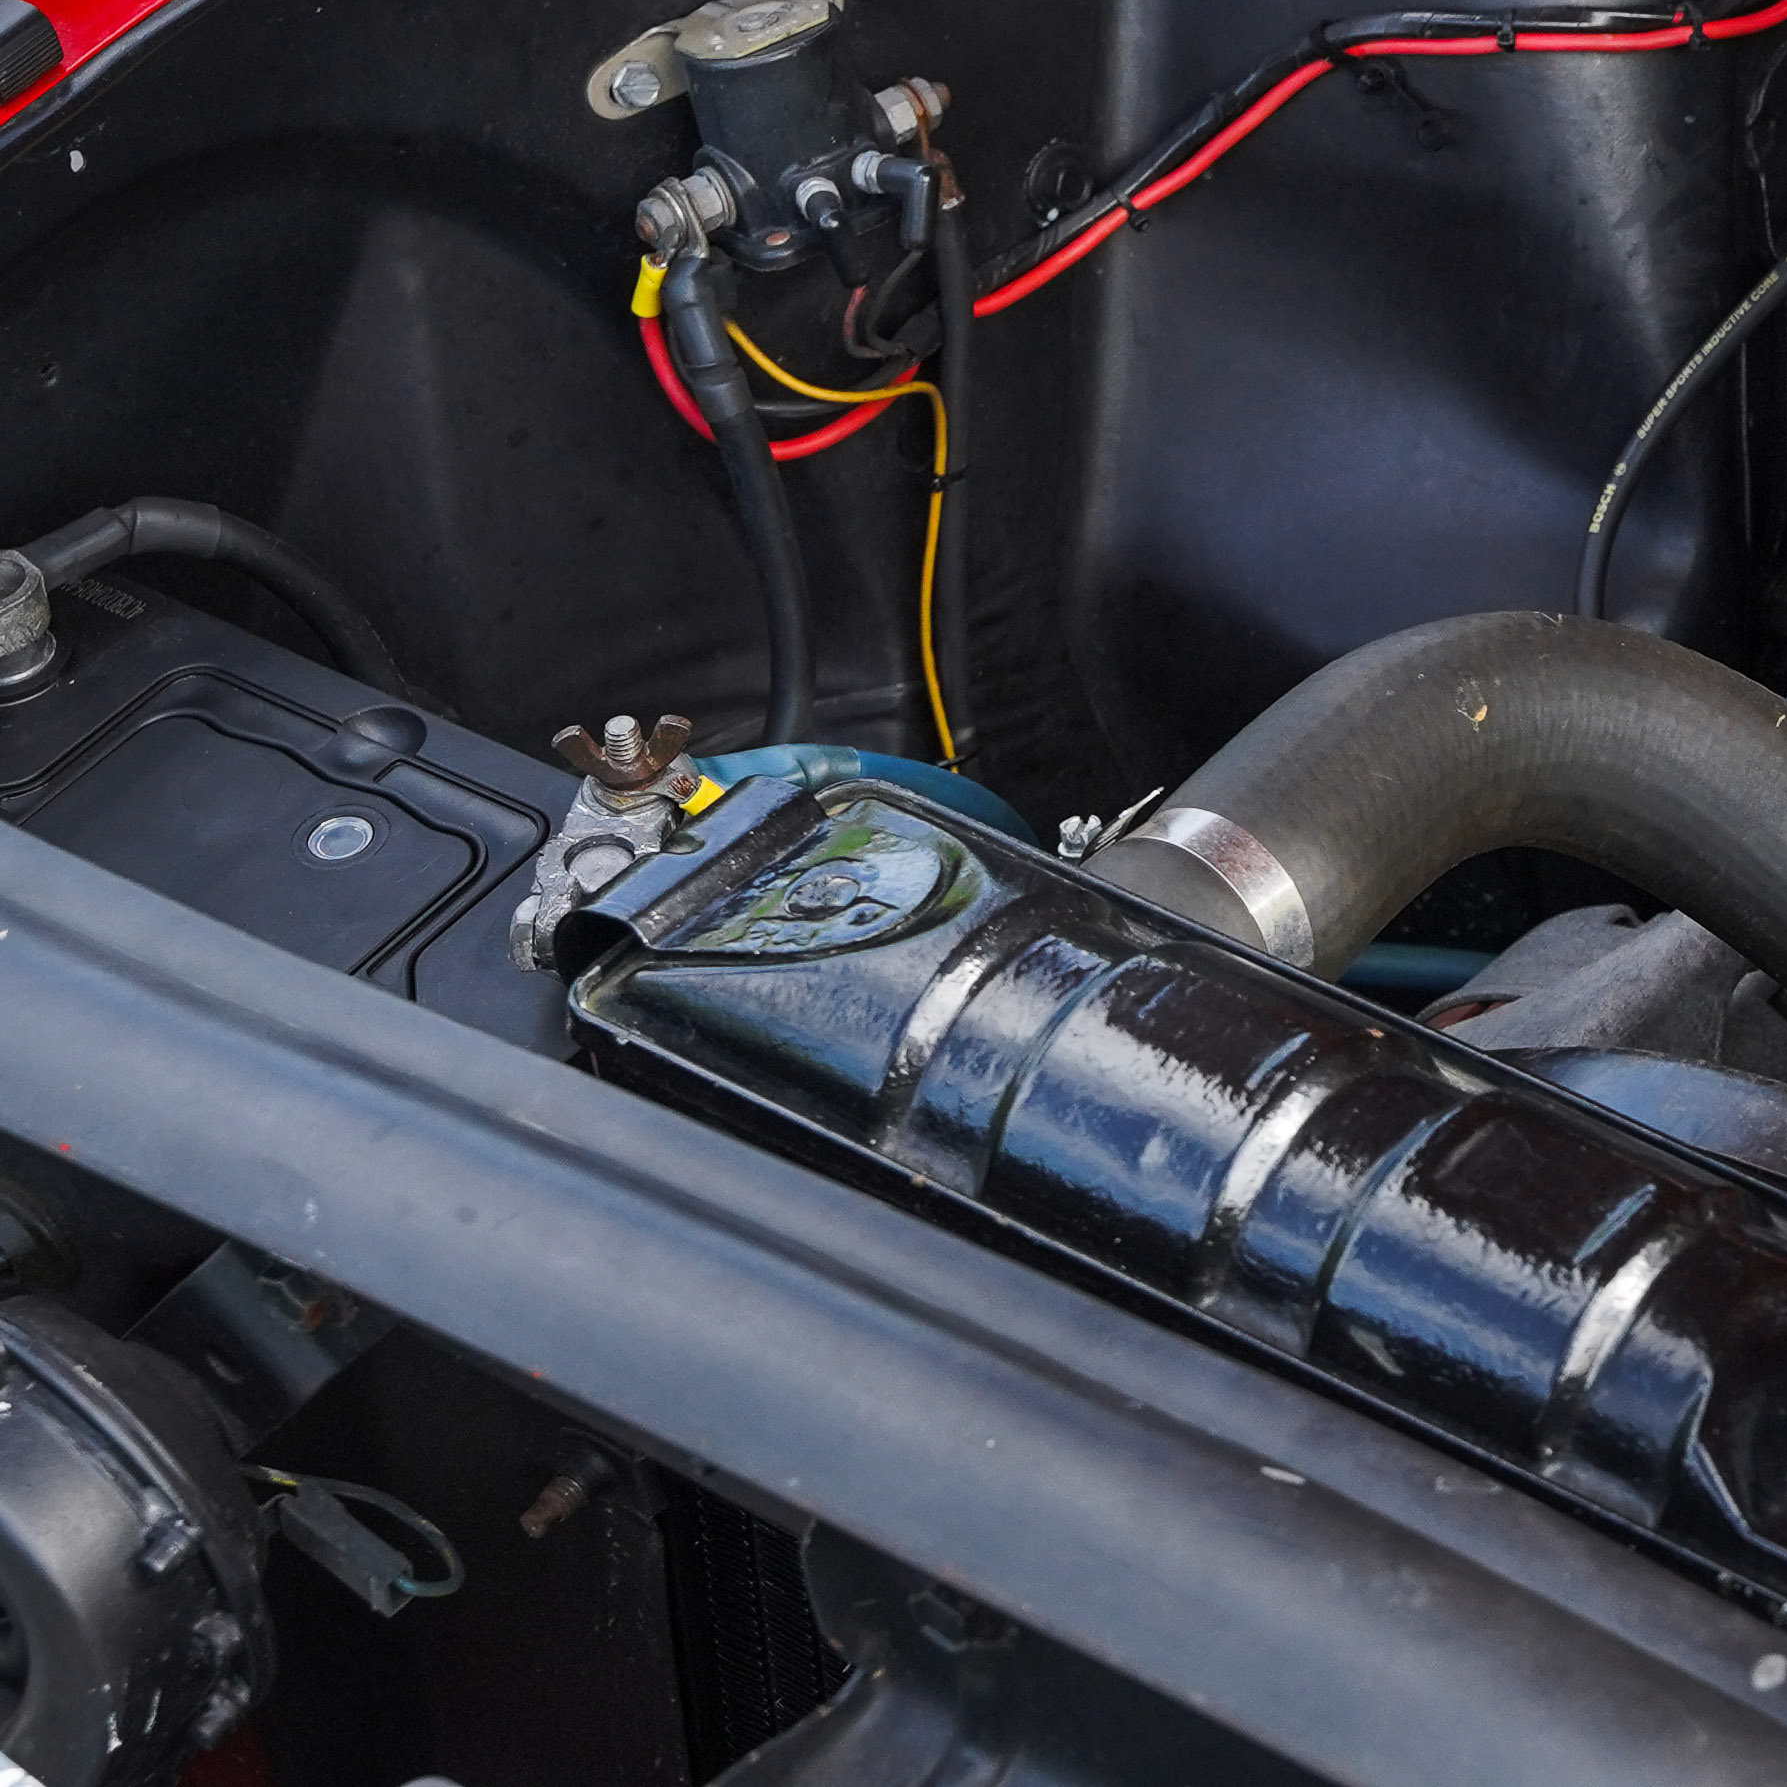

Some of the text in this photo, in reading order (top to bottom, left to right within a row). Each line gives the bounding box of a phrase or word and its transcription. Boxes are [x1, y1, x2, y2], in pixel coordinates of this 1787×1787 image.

[1588, 482, 1617, 534] BOSCH
[1636, 397, 1668, 440] SUPER
[1665, 353, 1704, 400] SPORTS
[1701, 298, 1752, 356] INDUCTIVE
[1750, 271, 1780, 302] CORE
